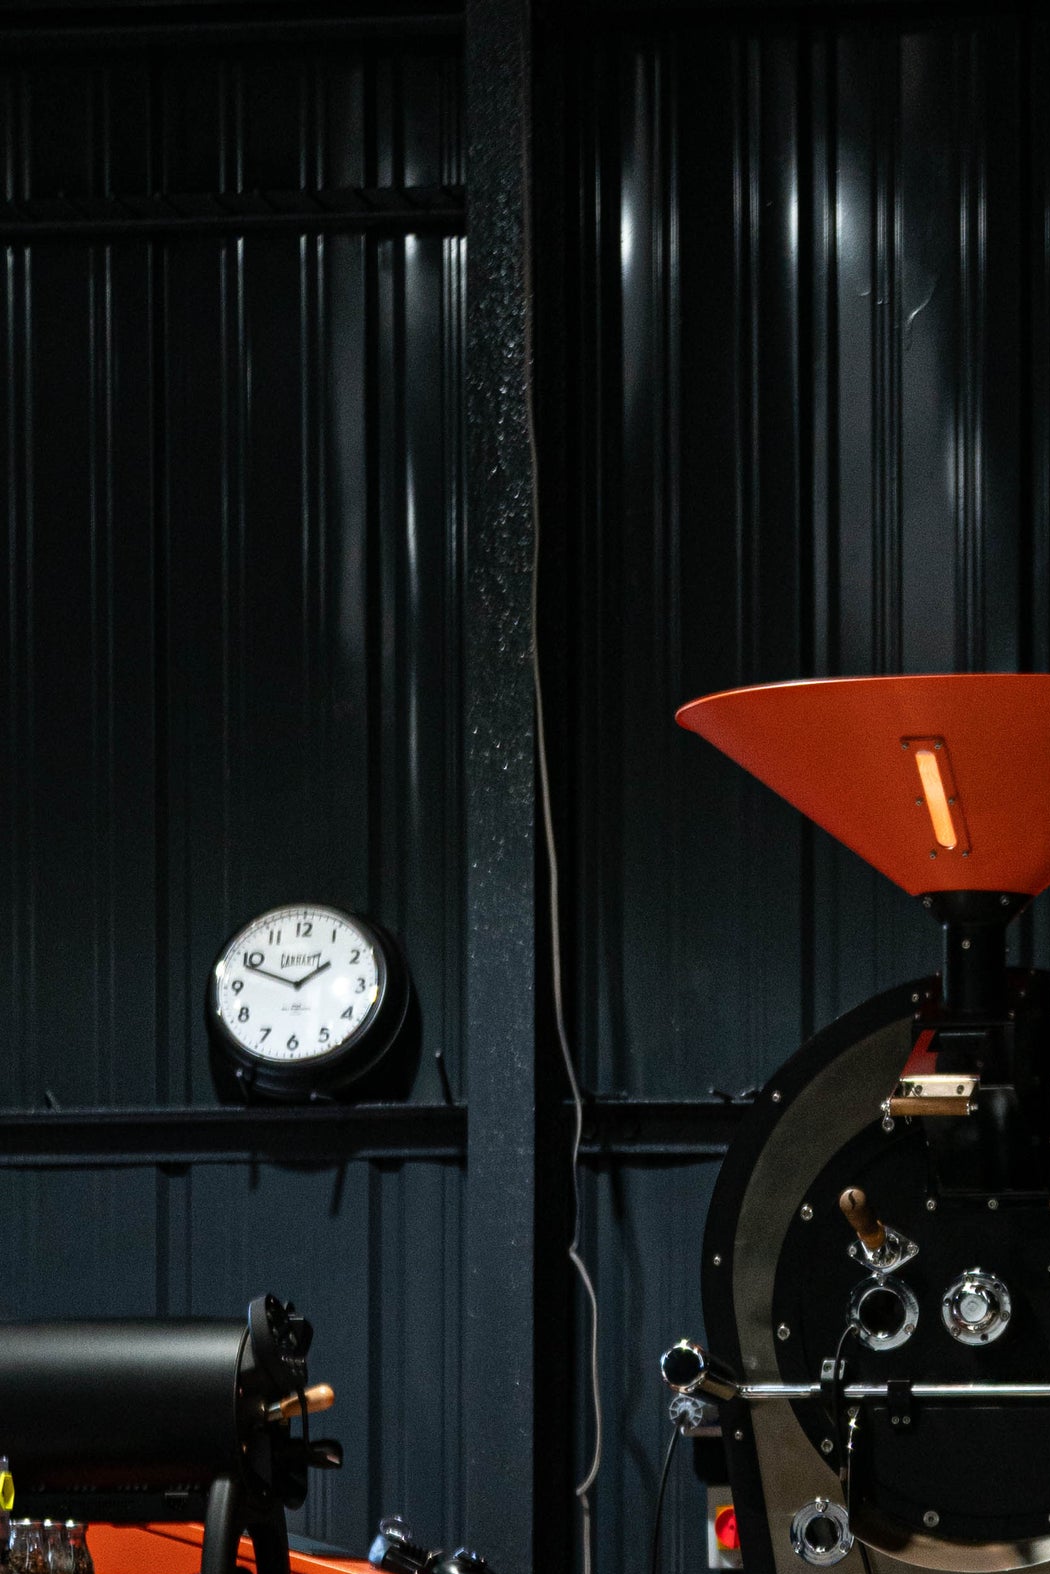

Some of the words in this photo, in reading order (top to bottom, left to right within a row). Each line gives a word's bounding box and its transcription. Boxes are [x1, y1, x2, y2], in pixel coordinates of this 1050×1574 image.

[268, 929, 282, 945] 11
[295, 922, 313, 938] 12
[331, 928, 337, 943] 1
[243, 951, 265, 968] 10
[349, 949, 361, 965] 2
[231, 980, 244, 996] 9
[355, 978, 366, 994] 3
[237, 1007, 250, 1023] 8
[340, 1005, 353, 1020] 4
[259, 1028, 272, 1043] 7
[318, 1027, 330, 1043] 5
[286, 1035, 299, 1052] 6
